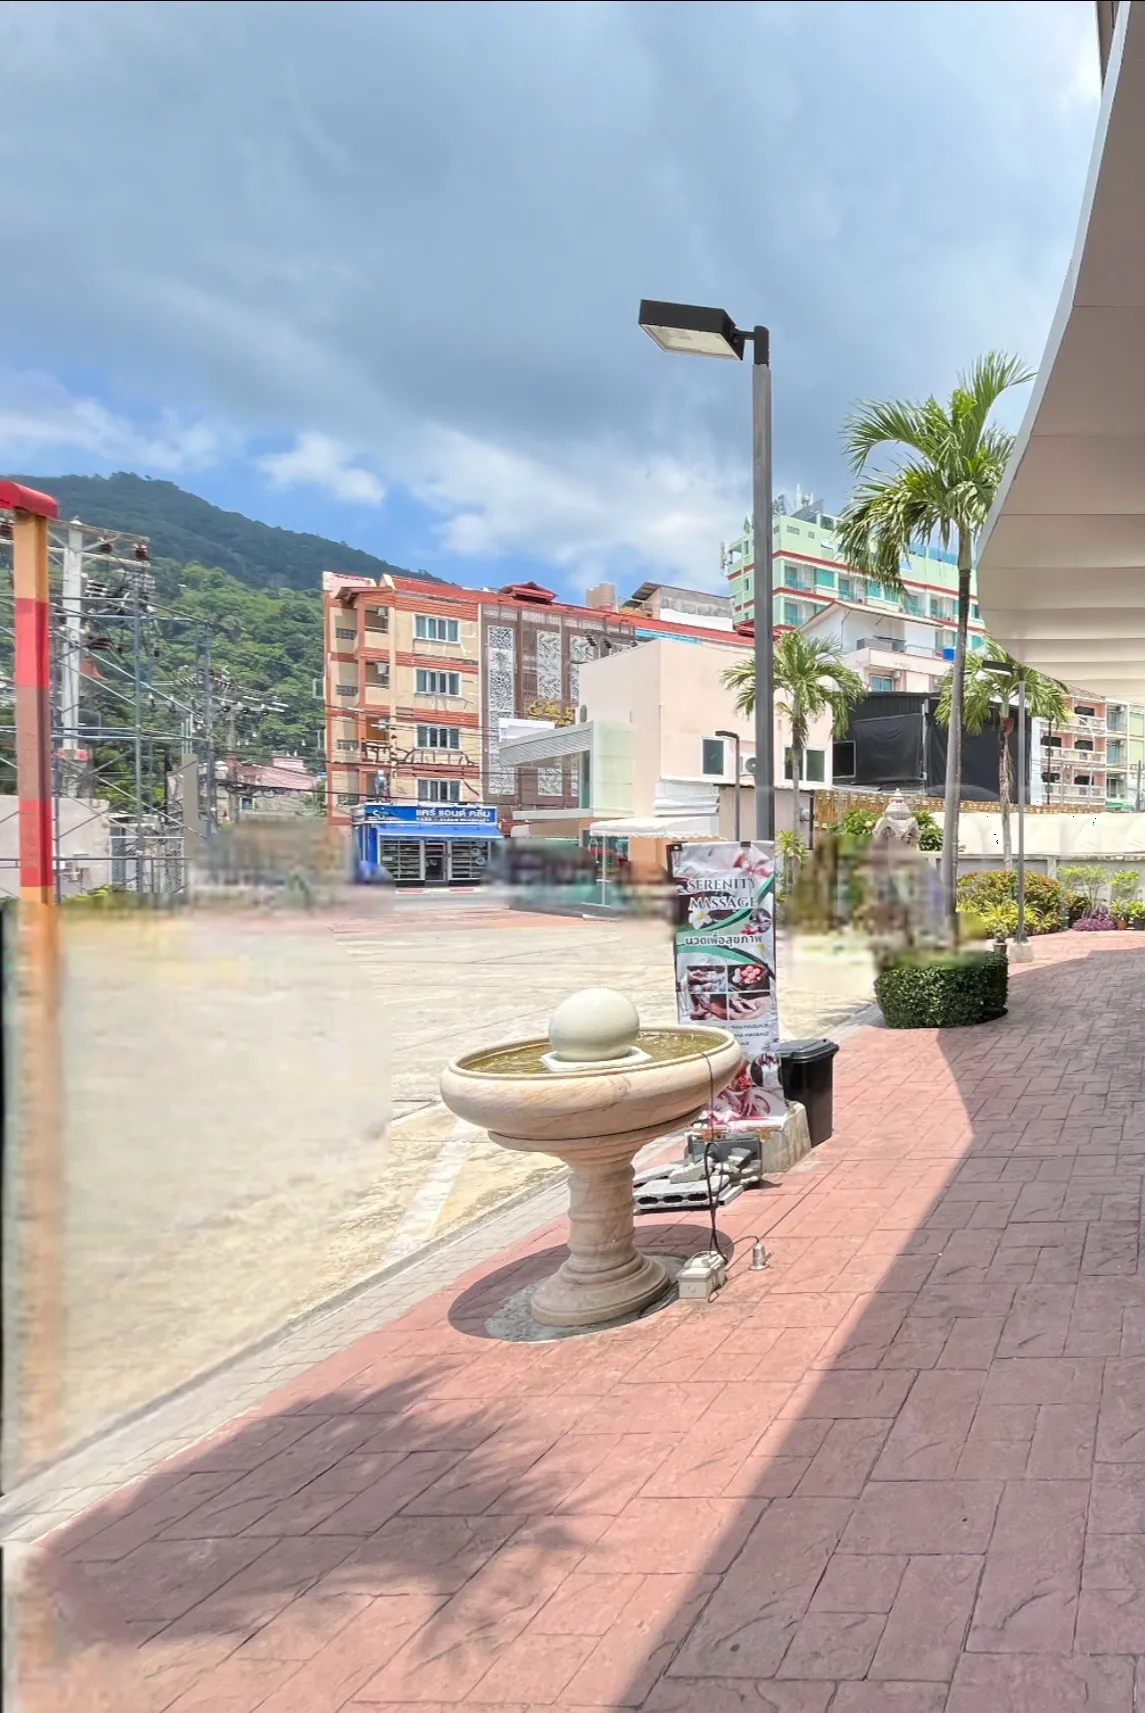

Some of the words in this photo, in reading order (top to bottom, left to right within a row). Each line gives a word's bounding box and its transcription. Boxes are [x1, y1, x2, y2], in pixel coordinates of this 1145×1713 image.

[688, 878, 756, 891] SERENITY
[689, 896, 755, 910] MASSAGE
[684, 931, 763, 947] นวดเพื่อสุขภาพ
